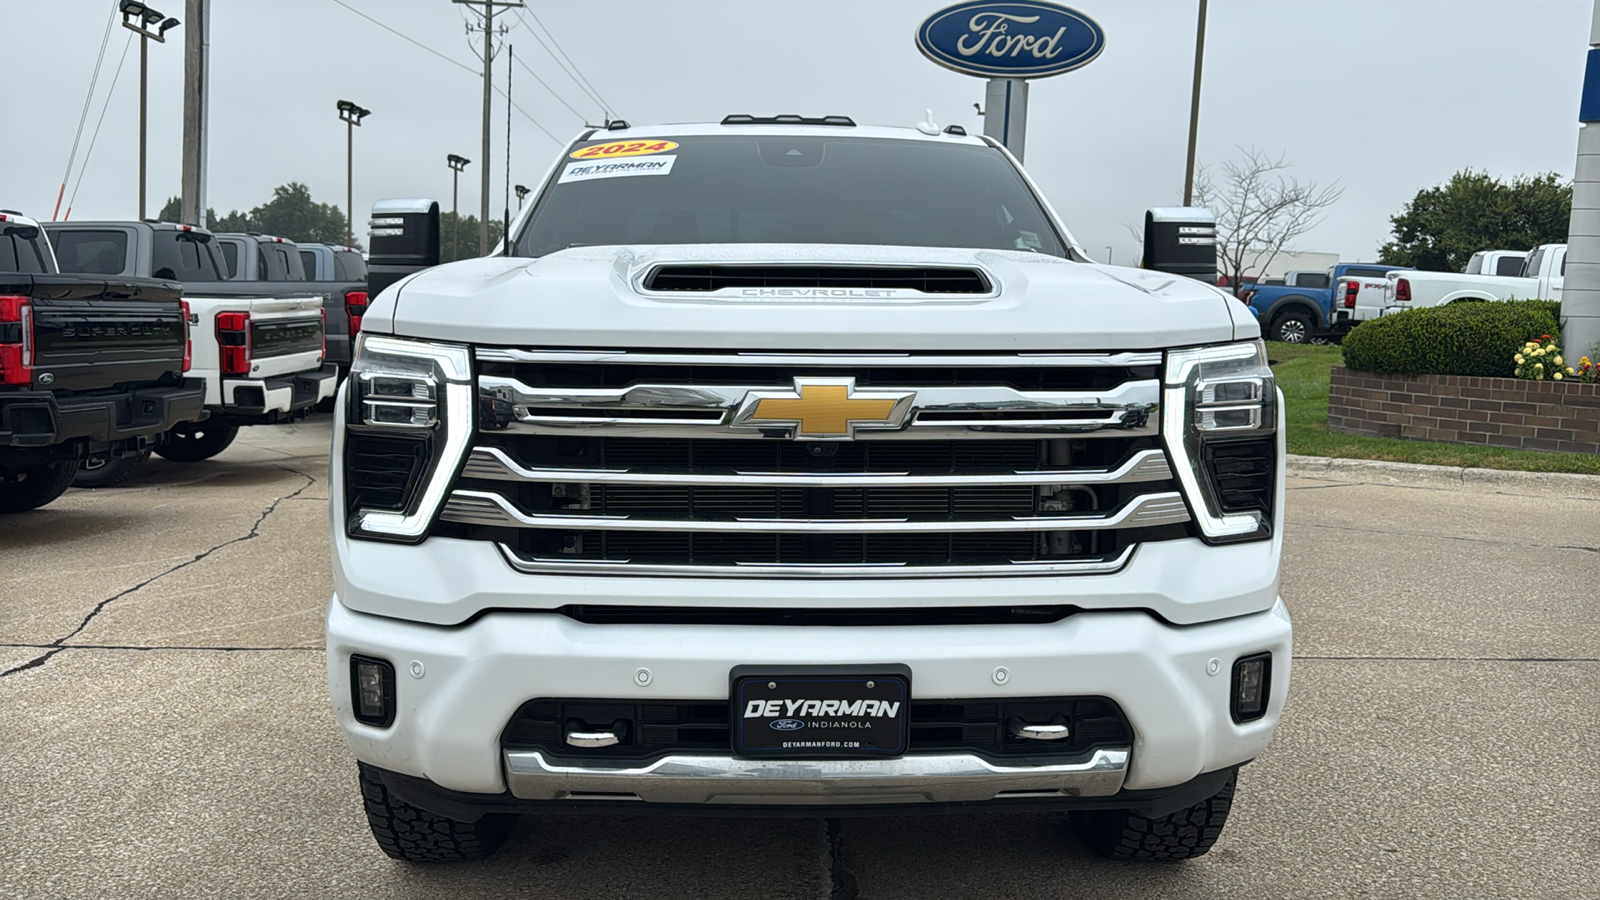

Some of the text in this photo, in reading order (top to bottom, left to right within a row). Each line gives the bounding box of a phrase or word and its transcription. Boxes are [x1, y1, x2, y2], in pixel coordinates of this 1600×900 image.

[957, 12, 1067, 59] Ford
[580, 142, 669, 158] 2024
[569, 161, 668, 175] DEYARMAN
[742, 289, 897, 297] CHEVROLET
[62, 326, 128, 337] SUPER
[743, 699, 900, 719] DEYARMAN
[776, 720, 872, 729] Ford INDIANOLA
